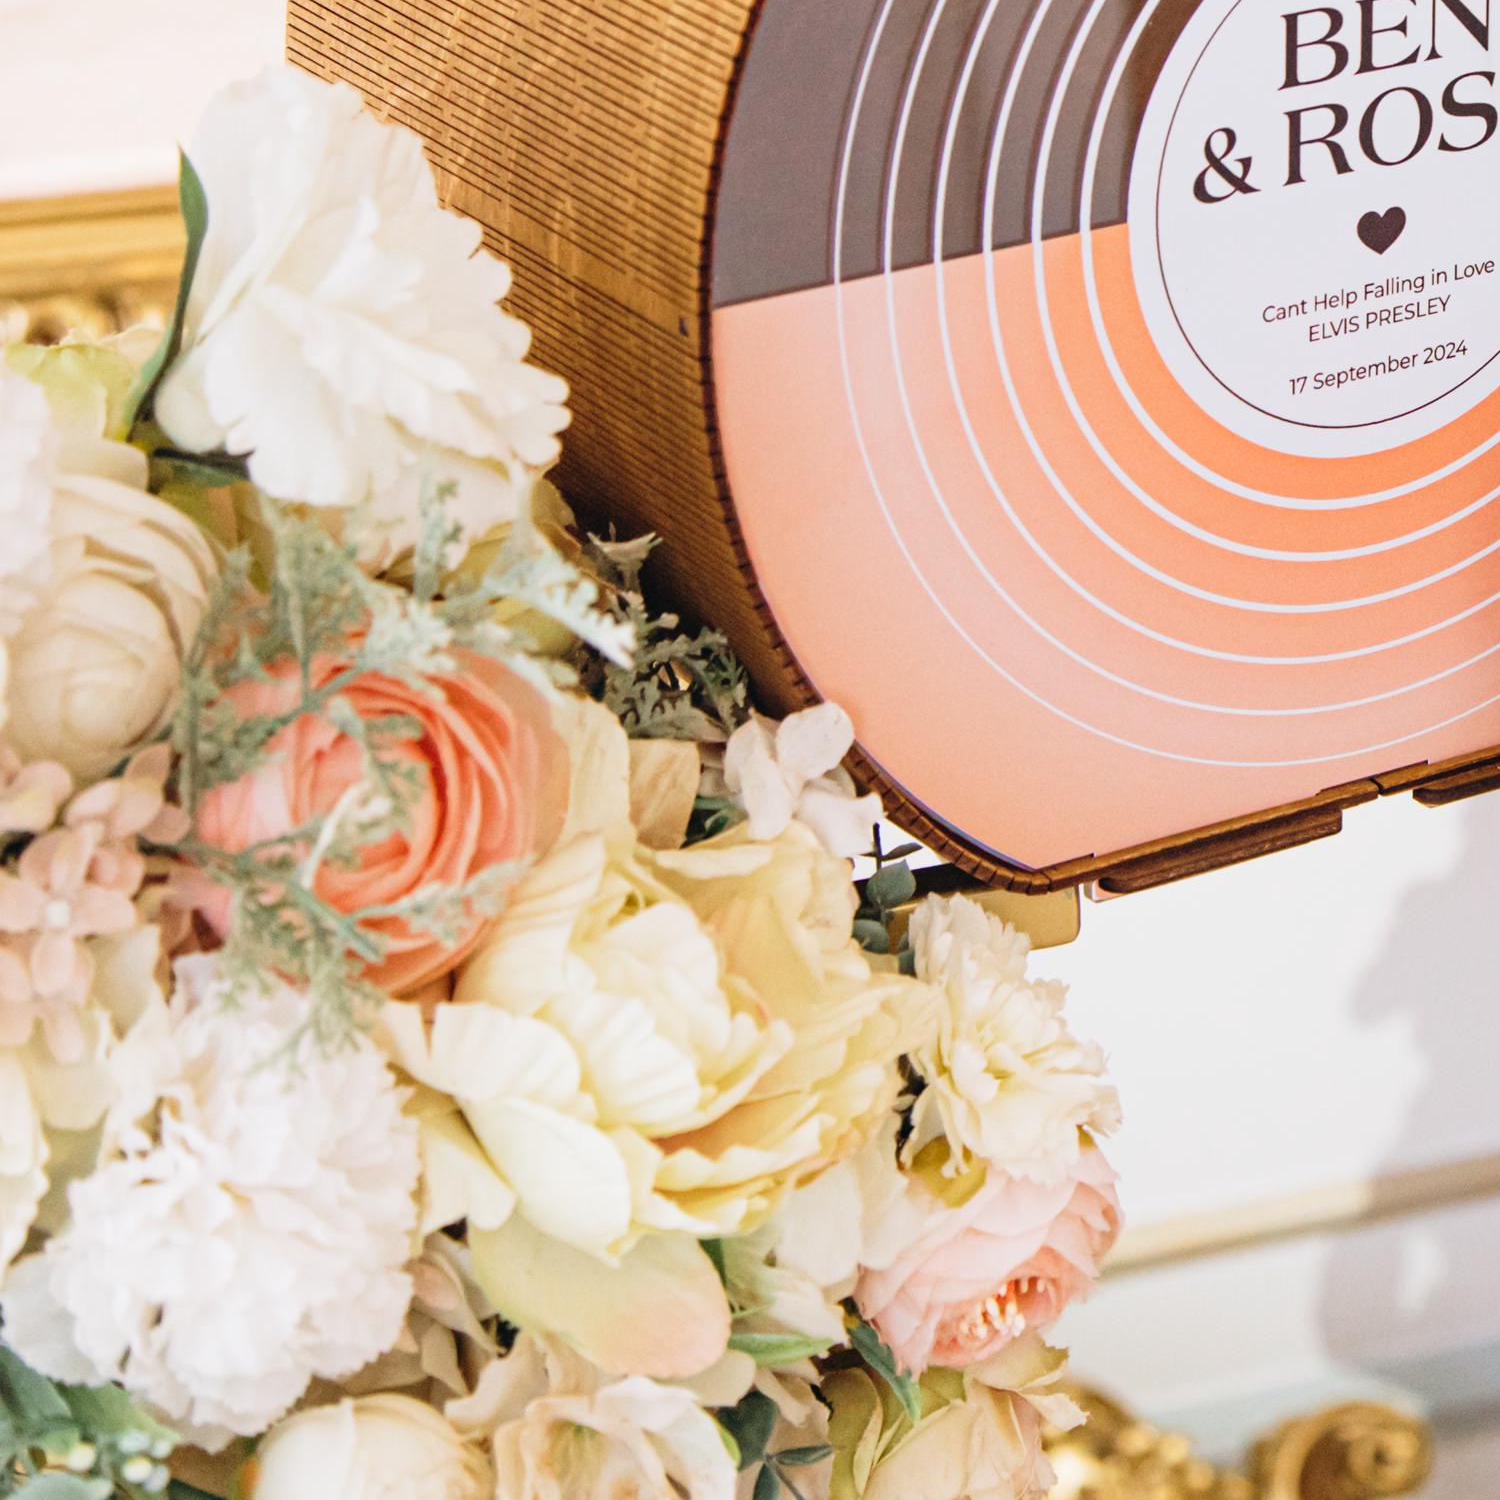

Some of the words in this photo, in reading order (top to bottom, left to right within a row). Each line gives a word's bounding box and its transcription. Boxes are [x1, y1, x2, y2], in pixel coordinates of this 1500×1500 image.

[1192, 127, 1261, 204] &
[1262, 299, 1308, 323] Cant
[1314, 288, 1358, 312] Help
[1364, 275, 1425, 301] Falling
[1431, 268, 1448, 286] in
[1454, 260, 1495, 281] Love
[1308, 315, 1360, 342] ELVIS
[1365, 294, 1451, 330] PRESLEY
[1289, 376, 1308, 395] 17
[1313, 352, 1419, 390] September
[1423, 339, 1468, 365] 2024
